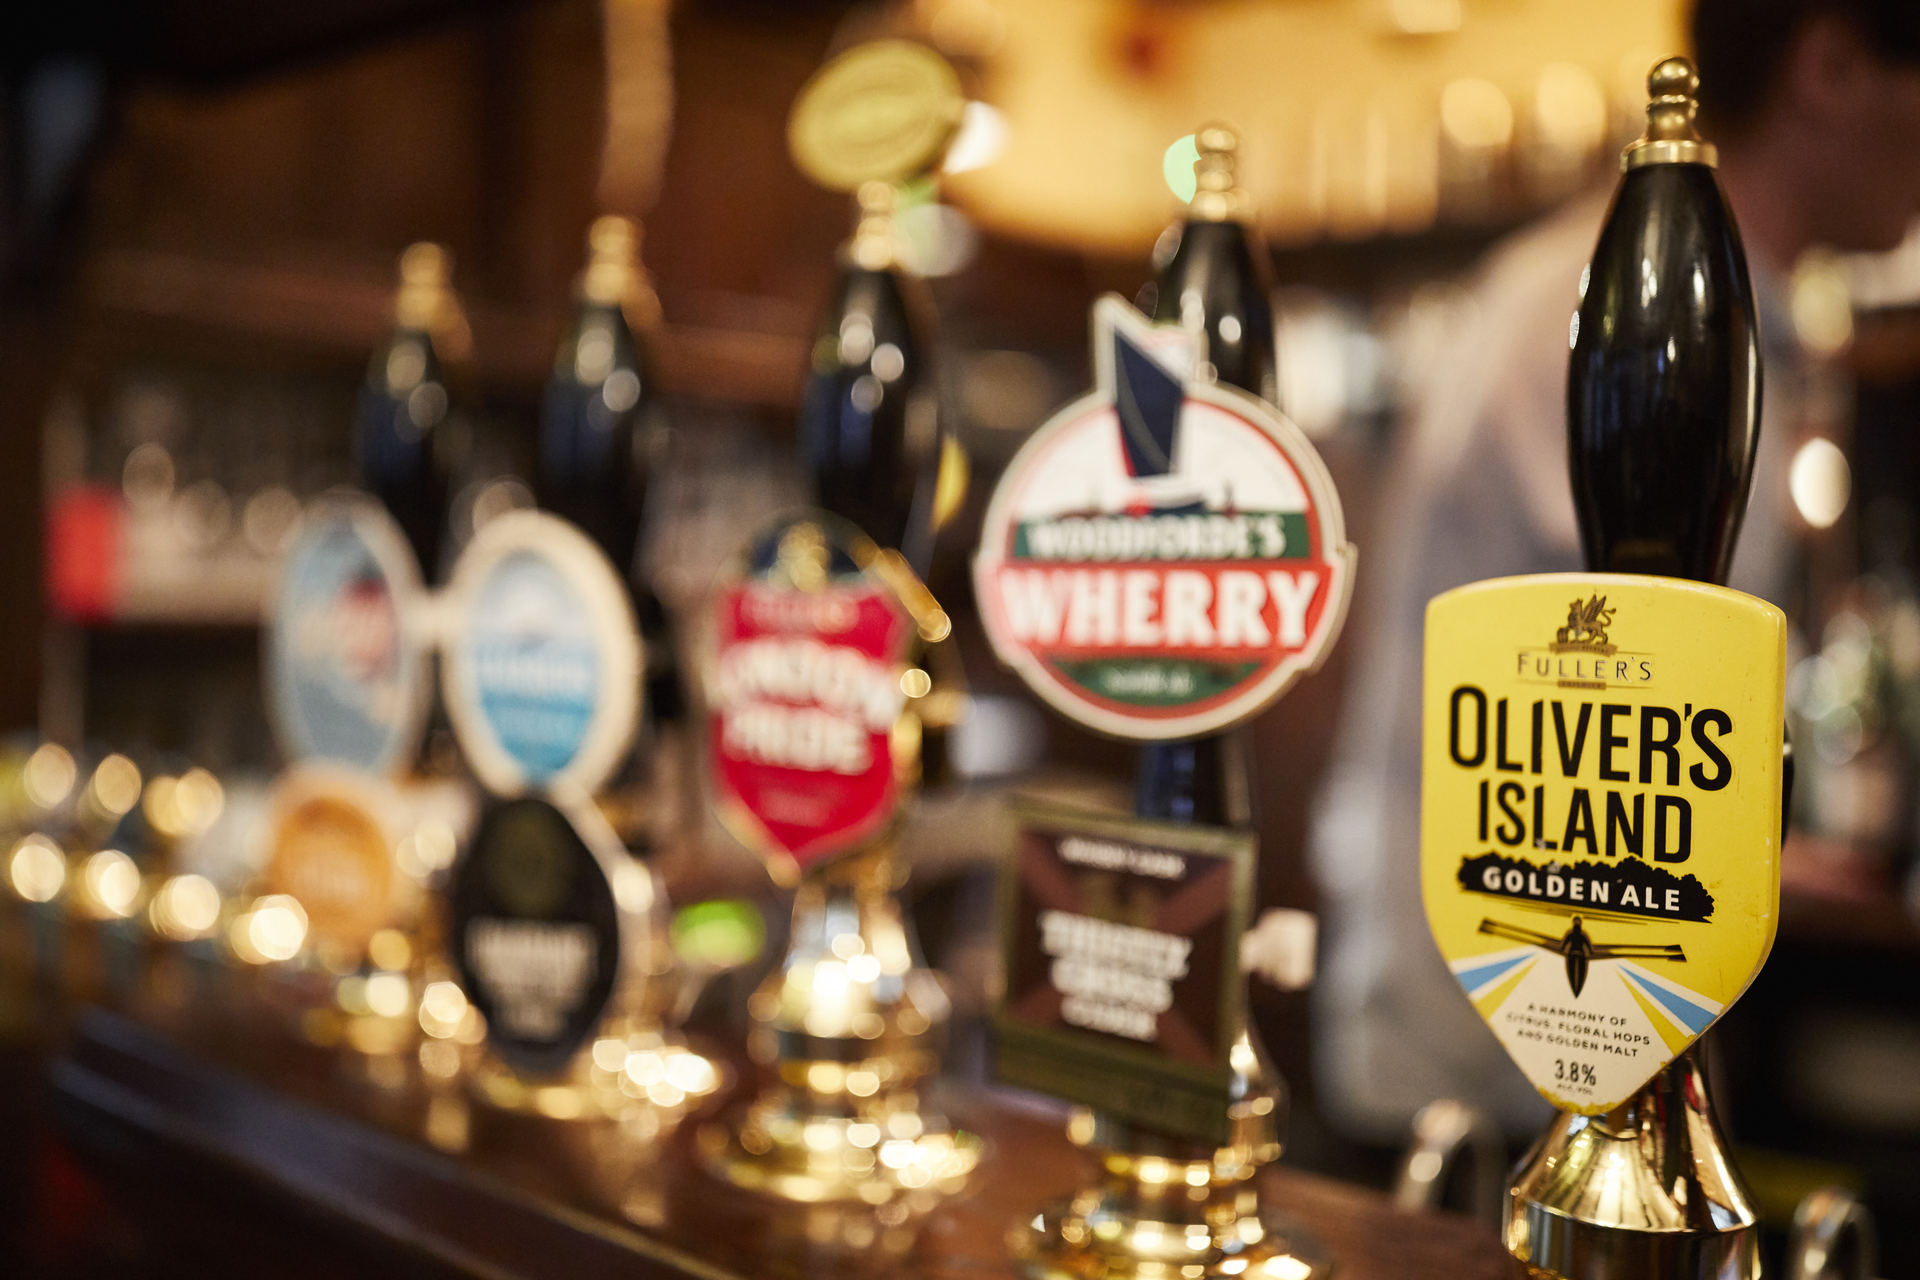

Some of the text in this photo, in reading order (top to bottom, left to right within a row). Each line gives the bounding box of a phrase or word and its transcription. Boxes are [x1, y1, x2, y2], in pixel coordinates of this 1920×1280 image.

[1001, 568, 1319, 648] WHERRY
[1517, 652, 1652, 681] FULLER'S
[1449, 684, 1733, 791] OLIVER'S
[1478, 779, 1692, 863] ISLAND
[1483, 866, 1681, 912] GOLDEN ALE
[1539, 1004, 1605, 1023] HARMONY
[1610, 1016, 1628, 1027] OF
[1517, 1029, 1639, 1058] AND GOLDEN MALT
[1558, 1021, 1609, 1039] FLORAL
[1613, 1031, 1651, 1046] HOPS
[1554, 1058, 1597, 1087] 3.8%
